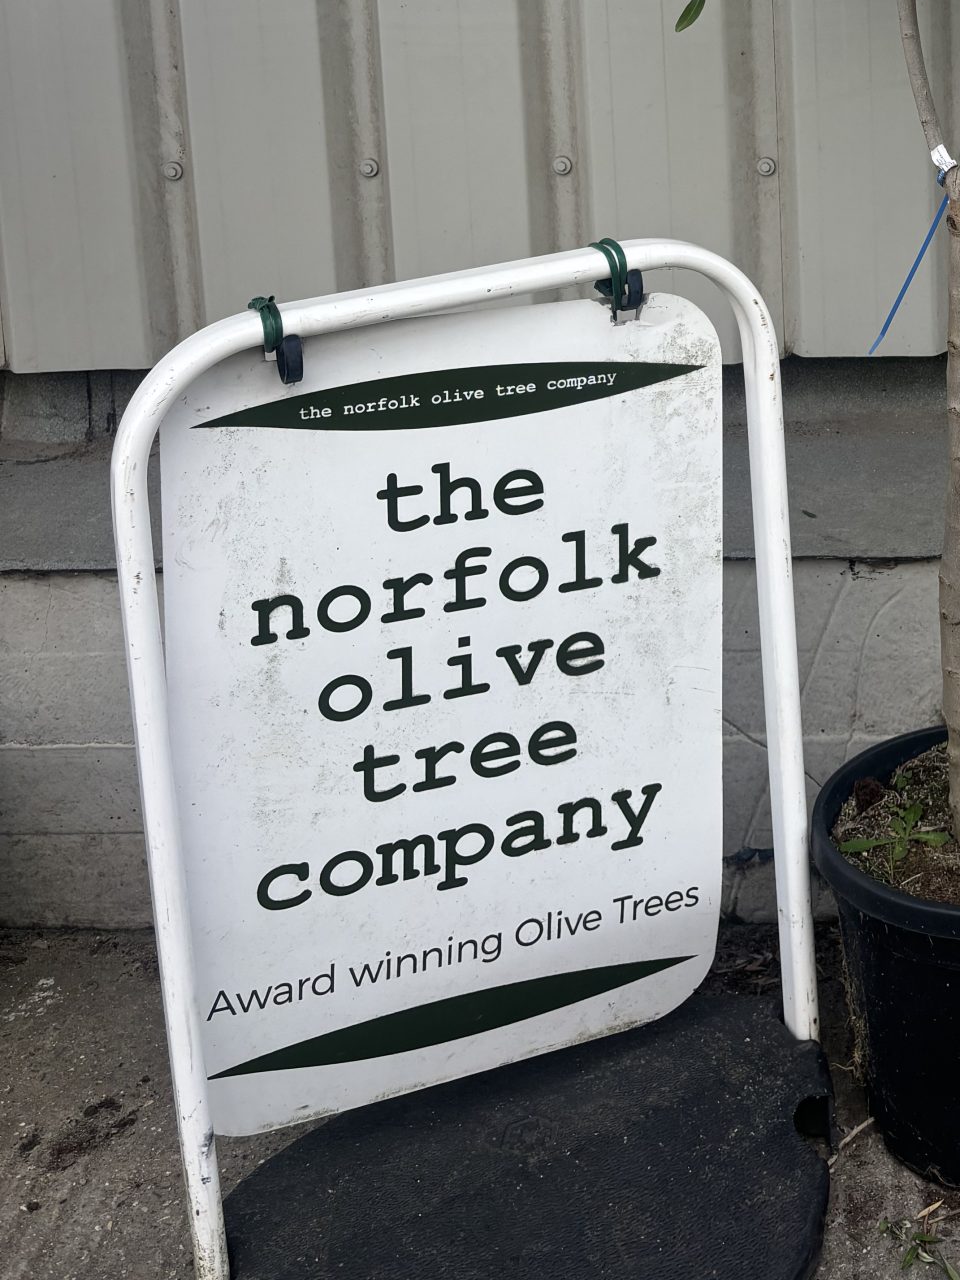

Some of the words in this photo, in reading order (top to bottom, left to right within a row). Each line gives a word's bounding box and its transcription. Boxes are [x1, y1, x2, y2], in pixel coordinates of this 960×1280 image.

[299, 407, 332, 420] the
[343, 393, 420, 415] norfolk
[431, 389, 485, 404] olive
[495, 382, 537, 397] tree
[546, 371, 617, 391] company
[376, 462, 545, 533] the
[250, 522, 661, 647] norfolk
[317, 630, 605, 722] olive
[352, 720, 578, 803] tree
[256, 782, 663, 911] company
[206, 963, 336, 1022] Award
[349, 931, 503, 990] winning
[514, 907, 603, 948] Olive
[613, 886, 700, 927] Trees
